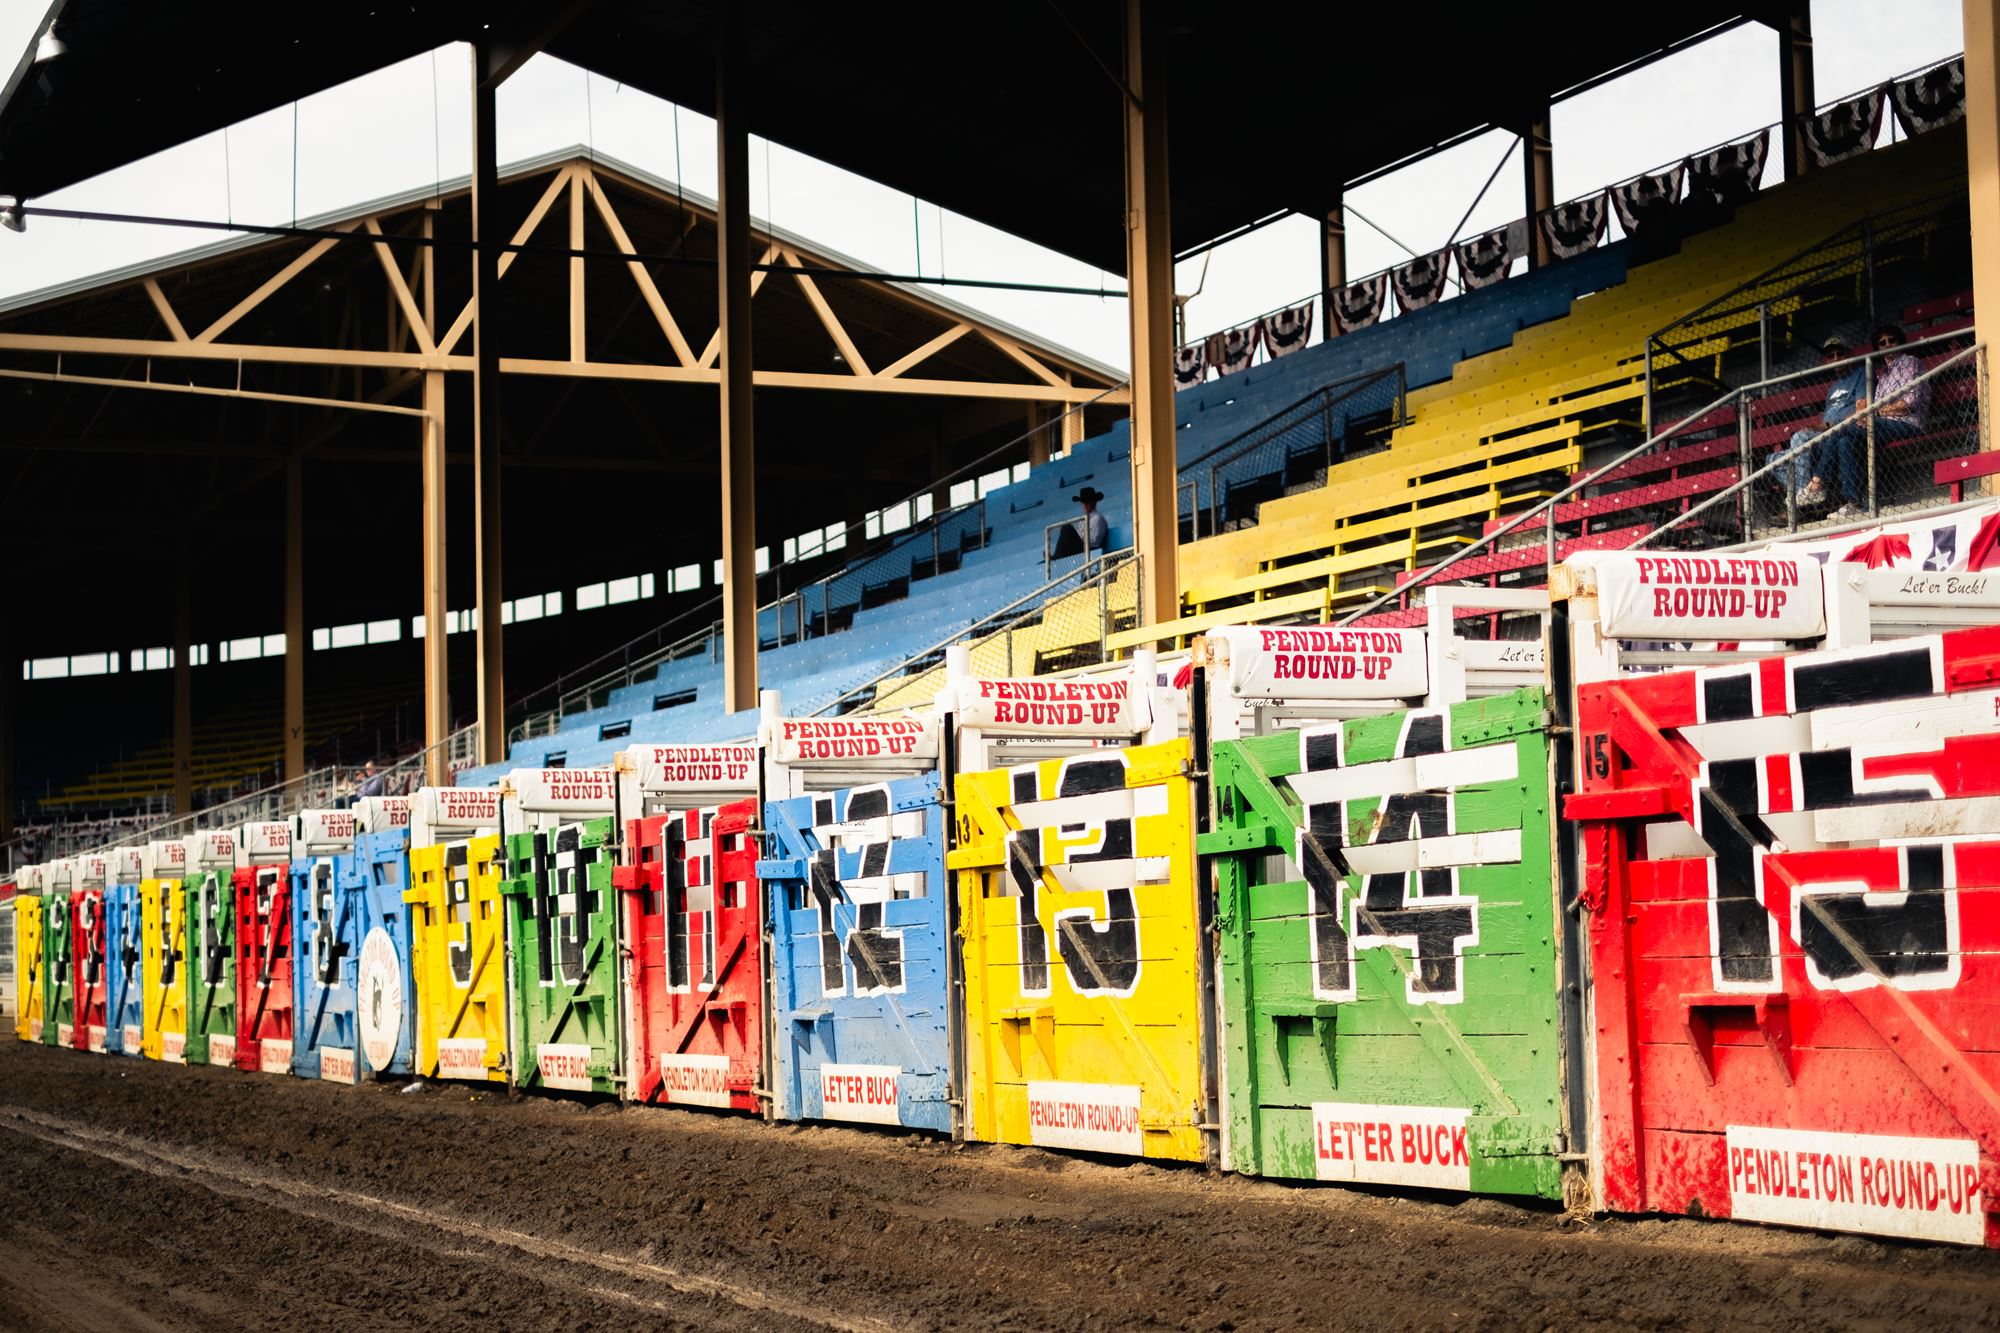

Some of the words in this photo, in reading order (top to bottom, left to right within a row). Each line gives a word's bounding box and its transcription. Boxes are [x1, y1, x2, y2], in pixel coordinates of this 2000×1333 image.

[1635, 557, 1799, 587] PENDLETON
[1900, 575, 1941, 594] Let'er
[1946, 576, 1987, 595] Buck!
[1653, 587, 1787, 618] ROUND-UP
[1259, 630, 1402, 653] PENDLETON
[1274, 654, 1392, 680] ROUND-UP
[979, 680, 1128, 702] PENDLETON
[994, 701, 1121, 725] ROUND-UP
[784, 720, 924, 739] PENDLETON
[654, 747, 755, 764] PENDLETON
[798, 735, 916, 759] ROUND-UP
[1585, 733, 1609, 780] 15
[663, 764, 748, 782] ROUND-UP
[1216, 784, 1234, 823] 14
[1692, 635, 1962, 993] 15
[957, 813, 970, 846] 13
[1295, 704, 1479, 1005] 14
[808, 782, 907, 999] 12
[1006, 752, 1143, 999] 13
[444, 839, 475, 989] 9
[539, 1055, 568, 1078] LET'ER
[663, 1066, 700, 1091] PENDLETON
[823, 1074, 863, 1103] LET'ER
[1030, 1100, 1085, 1130] PENDLETON
[1087, 1103, 1140, 1133] ROUND-UP
[1317, 1121, 1395, 1163] LET'ER
[1400, 1123, 1469, 1167] BUCK
[1731, 1146, 1854, 1204] PENDLETON
[1860, 1156, 1980, 1215] ROUND-UP
